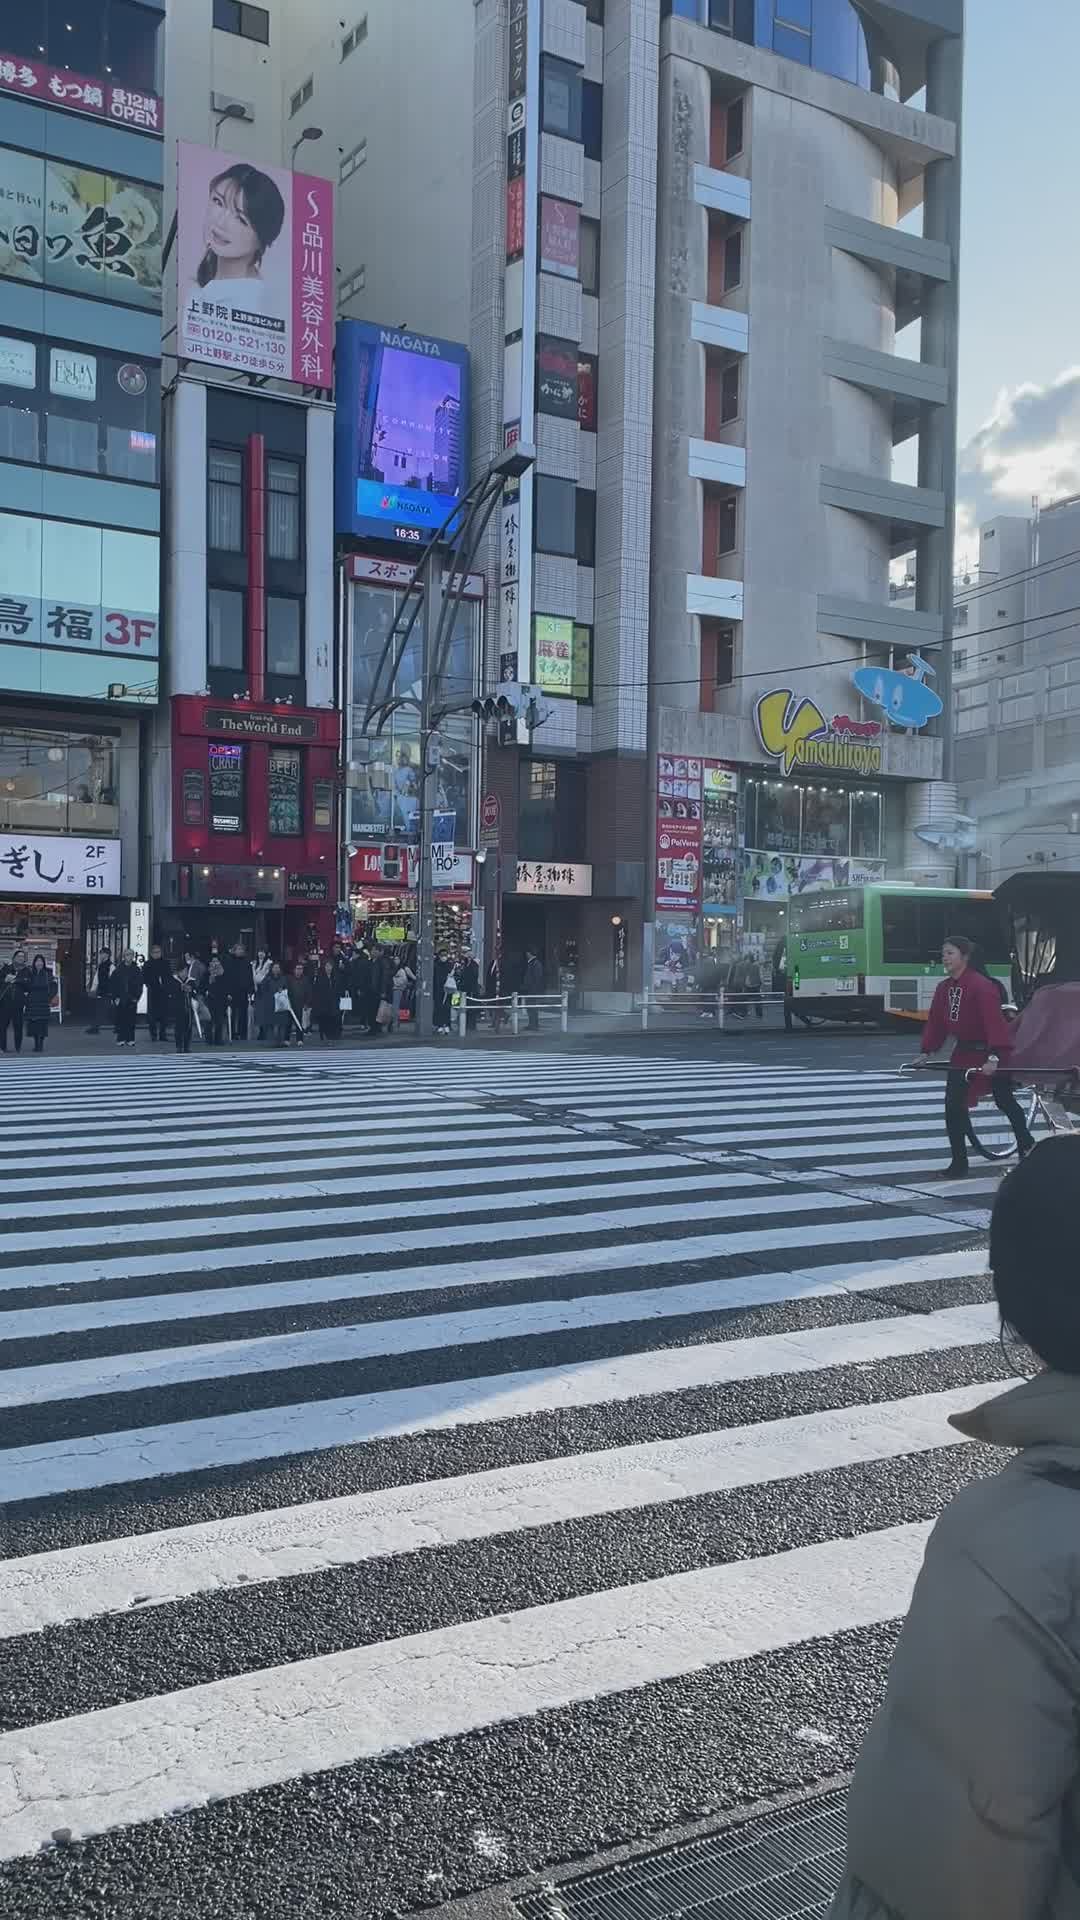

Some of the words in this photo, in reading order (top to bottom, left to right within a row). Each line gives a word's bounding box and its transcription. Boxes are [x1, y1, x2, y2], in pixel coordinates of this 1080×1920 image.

[111, 103, 158, 127] OPEN
[187, 298, 228, 321] 上野院
[300, 222, 325, 381] 品川美容外科
[380, 331, 441, 356] NAGATA
[187, 343, 285, 372] JR上野駅より徒歩5分
[394, 527, 420, 541] 16:35
[105, 613, 156, 647] 3F
[281, 724, 302, 736] End
[754, 688, 883, 777] Yamashiroya
[209, 746, 240, 756] OPEN
[269, 760, 297, 777] BEER
[86, 845, 106, 858] 2F
[86, 875, 105, 889] B1
[289, 881, 309, 890] Irish
[310, 882, 326, 891] Pub
[135, 908, 145, 916] B1
